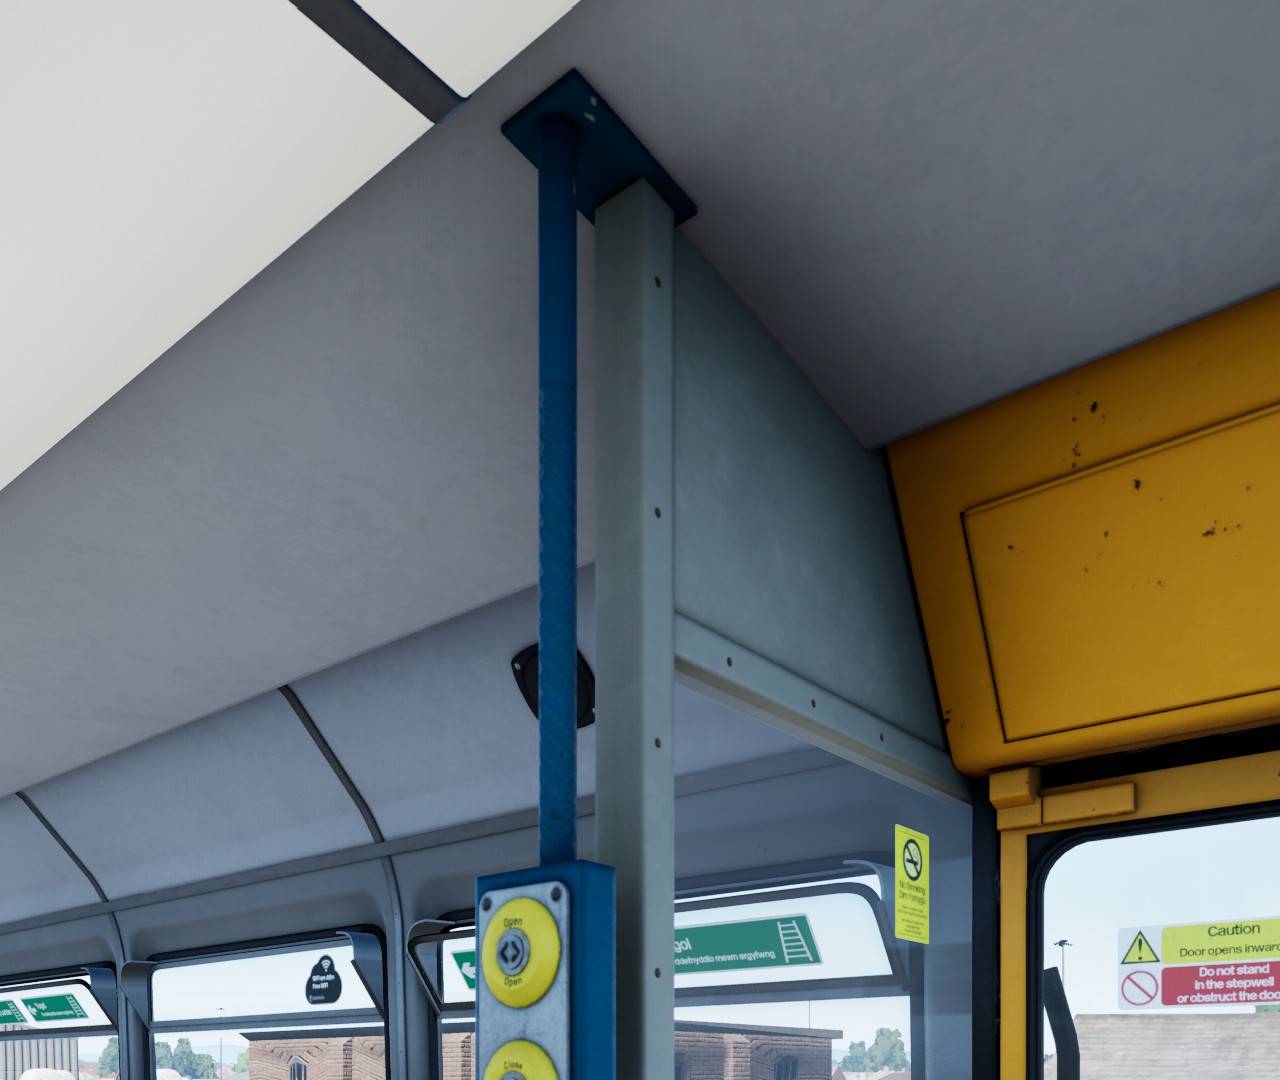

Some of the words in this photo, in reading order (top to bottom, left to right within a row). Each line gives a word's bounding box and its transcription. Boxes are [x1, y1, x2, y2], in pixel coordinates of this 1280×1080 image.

[503, 917, 523, 928] Open
[1207, 923, 1260, 938] Caution
[1179, 947, 1205, 958] Door
[1208, 945, 1243, 957] opens
[1199, 967, 1215, 977] Do
[1216, 965, 1236, 977] not
[1237, 964, 1270, 975] stand
[504, 976, 523, 988] Open
[1194, 980, 1205, 990] in
[1206, 979, 1225, 990] the
[1226, 976, 1275, 992] stepwell
[1177, 995, 1189, 1004] or
[1189, 991, 1238, 1004] obstruct
[1239, 990, 1258, 1001] the
[503, 1060, 523, 1071] Close
